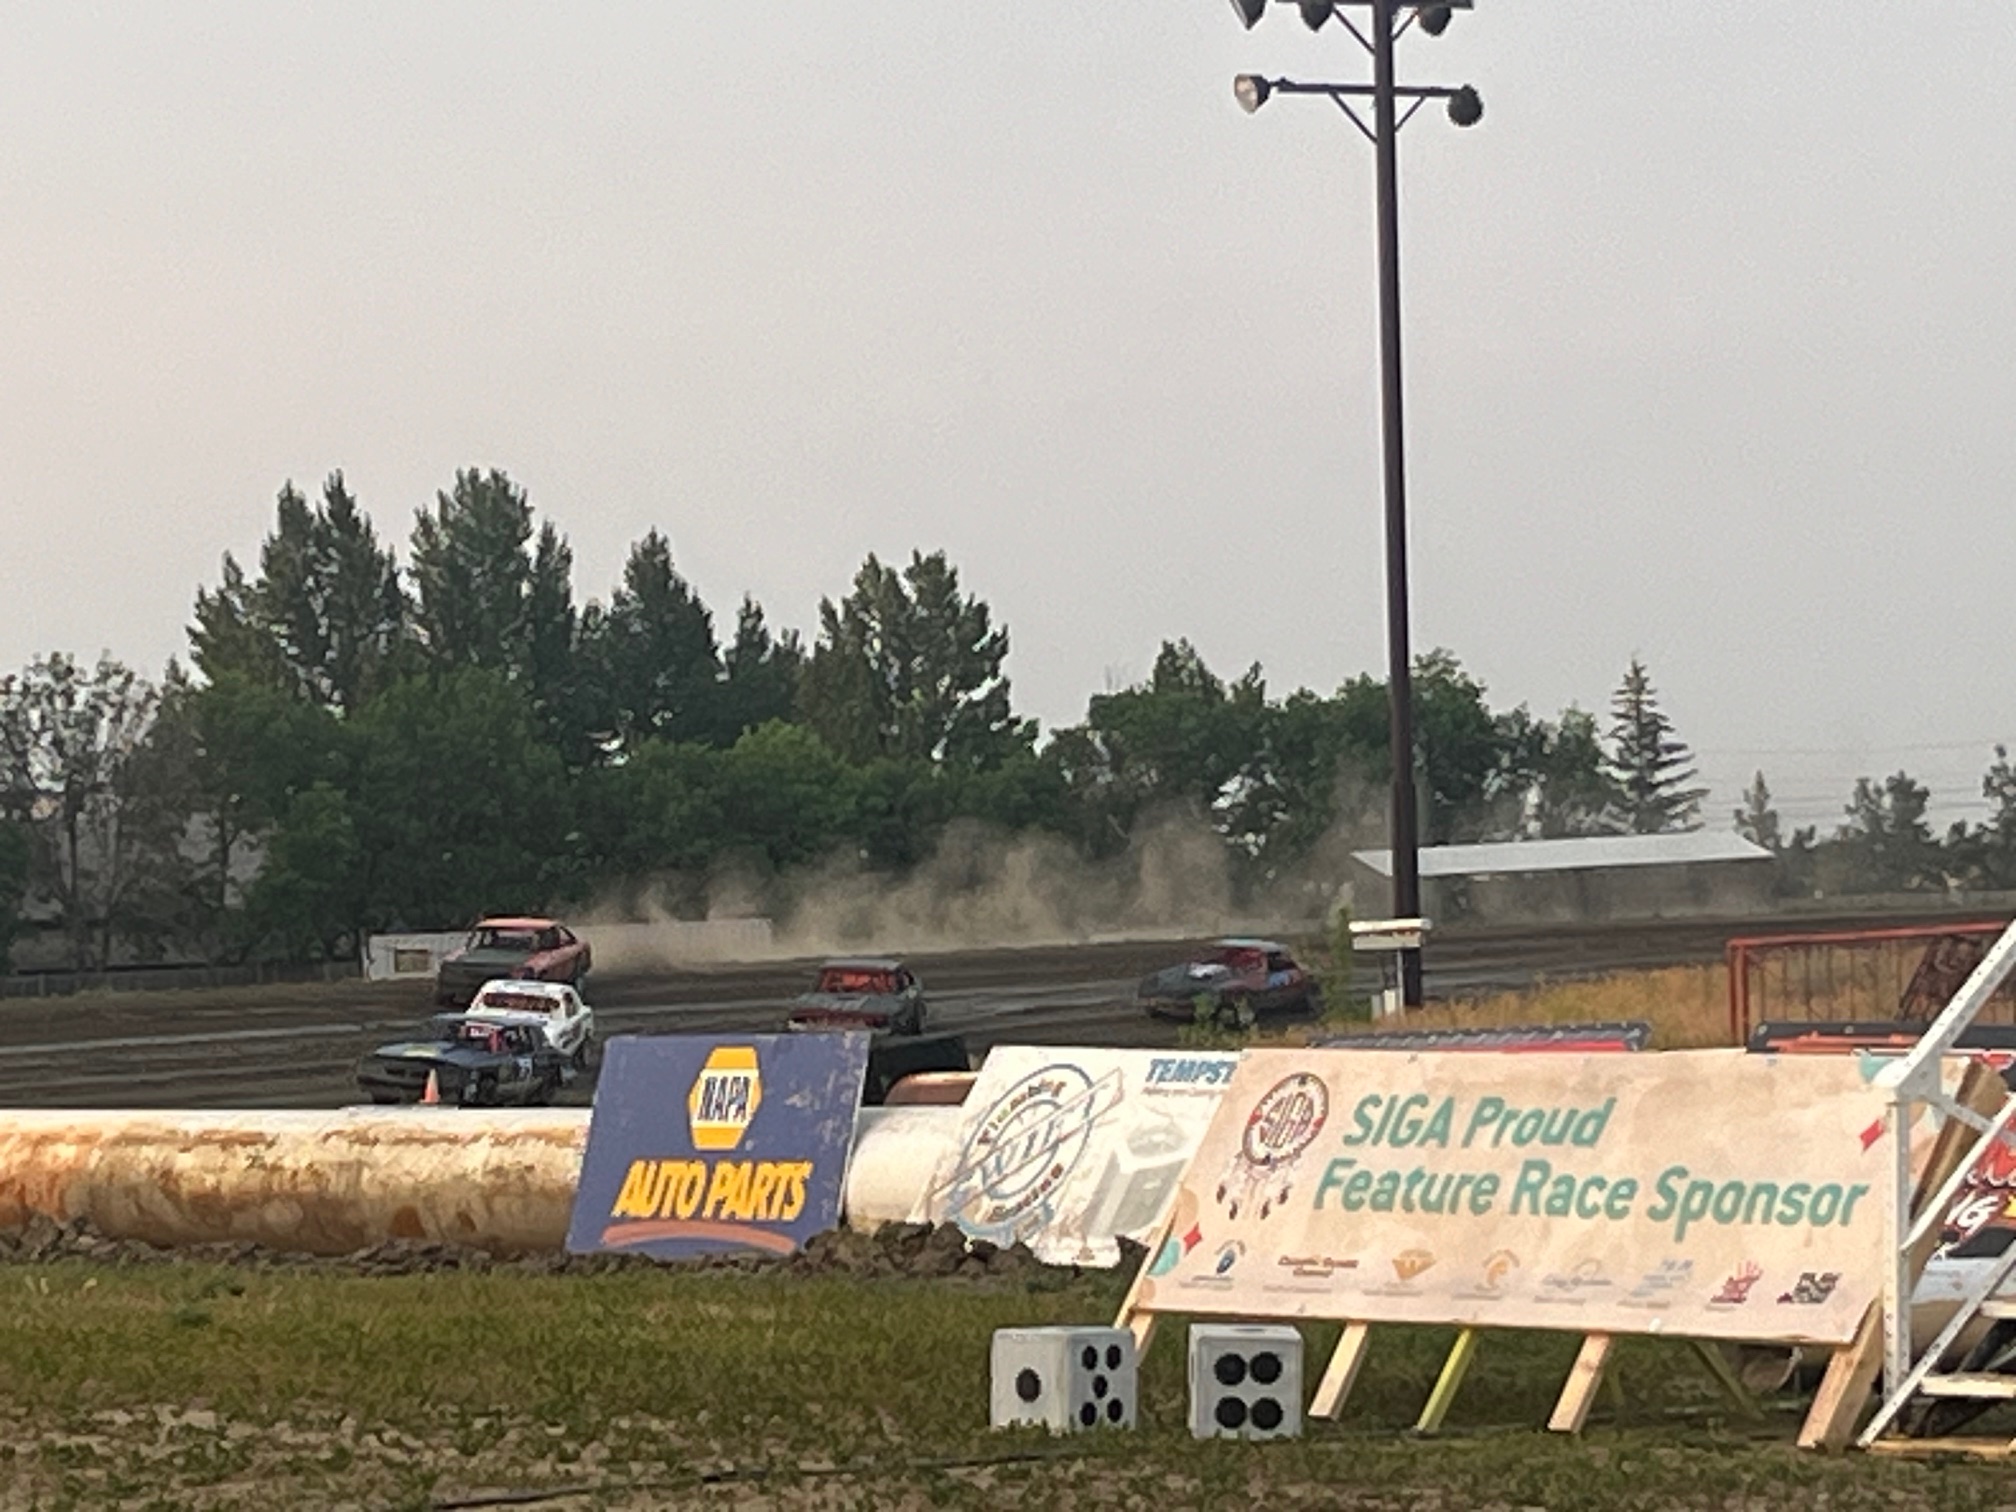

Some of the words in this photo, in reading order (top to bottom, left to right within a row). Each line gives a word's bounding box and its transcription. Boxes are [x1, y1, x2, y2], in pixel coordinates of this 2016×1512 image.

[697, 1075, 752, 1123] NAPA
[1342, 1094, 1456, 1149] SIGA
[1460, 1096, 1618, 1149] Proud
[611, 1160, 707, 1218] AUTO
[702, 1159, 814, 1221] PARTS
[1313, 1157, 1501, 1217] Feature
[1508, 1159, 1639, 1220] Race
[1647, 1165, 1869, 1243] Sponsor
